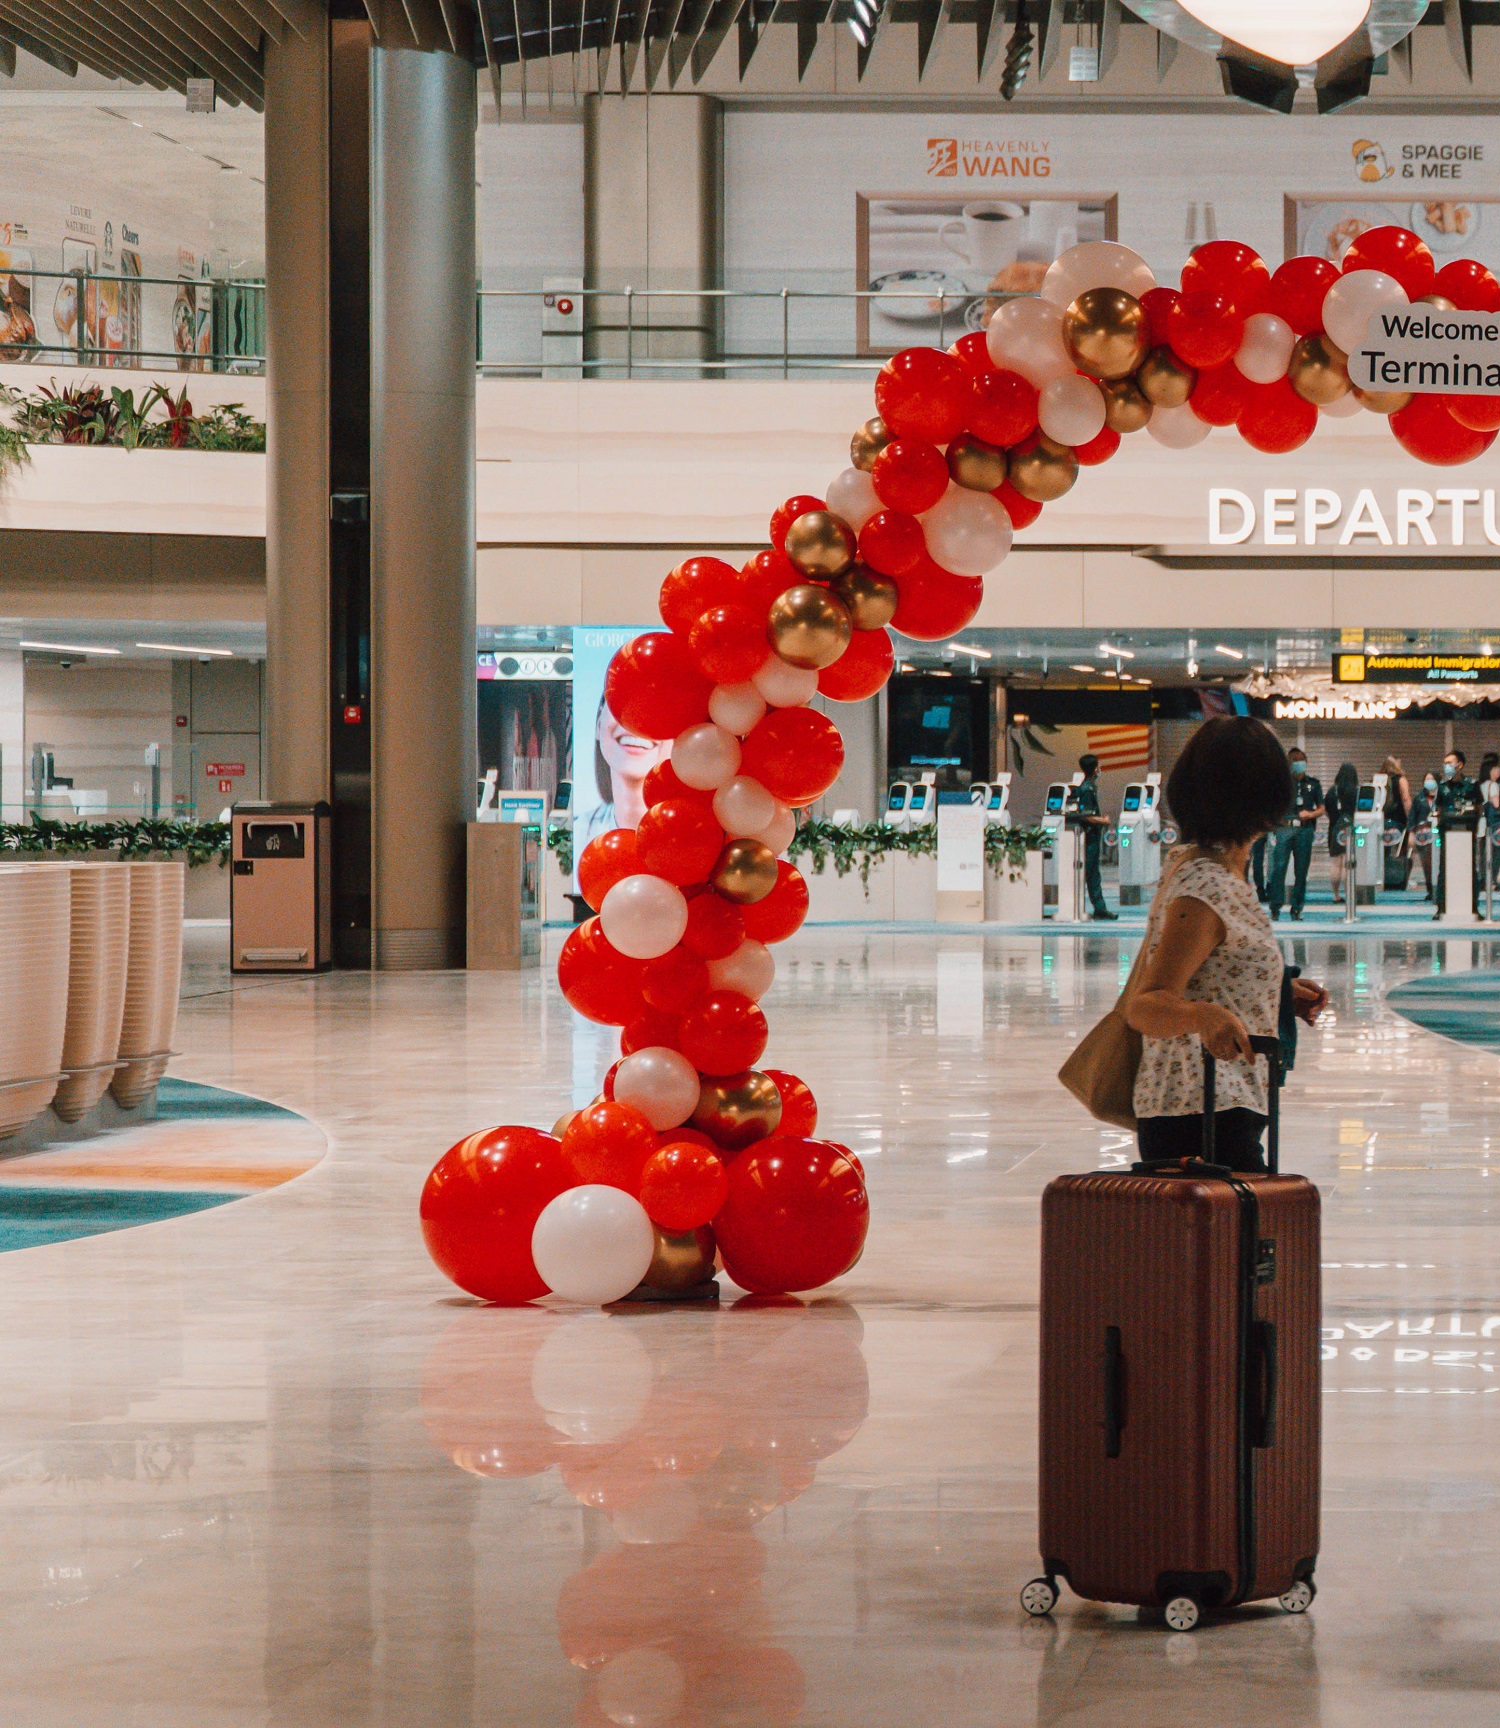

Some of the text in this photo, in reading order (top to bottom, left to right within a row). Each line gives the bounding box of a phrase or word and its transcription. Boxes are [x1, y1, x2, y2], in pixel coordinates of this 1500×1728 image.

[961, 140, 1050, 153] HEAVENLY
[1401, 144, 1484, 161] SPAGGIE
[962, 156, 1051, 177] WANG
[1401, 163, 1463, 179] & MEE
[121, 223, 140, 247] Cheers
[1380, 314, 1499, 343] Welcome
[1366, 655, 1432, 669] Automated
[1426, 669, 1439, 680] All
[1275, 700, 1397, 719] MONTBLANC
